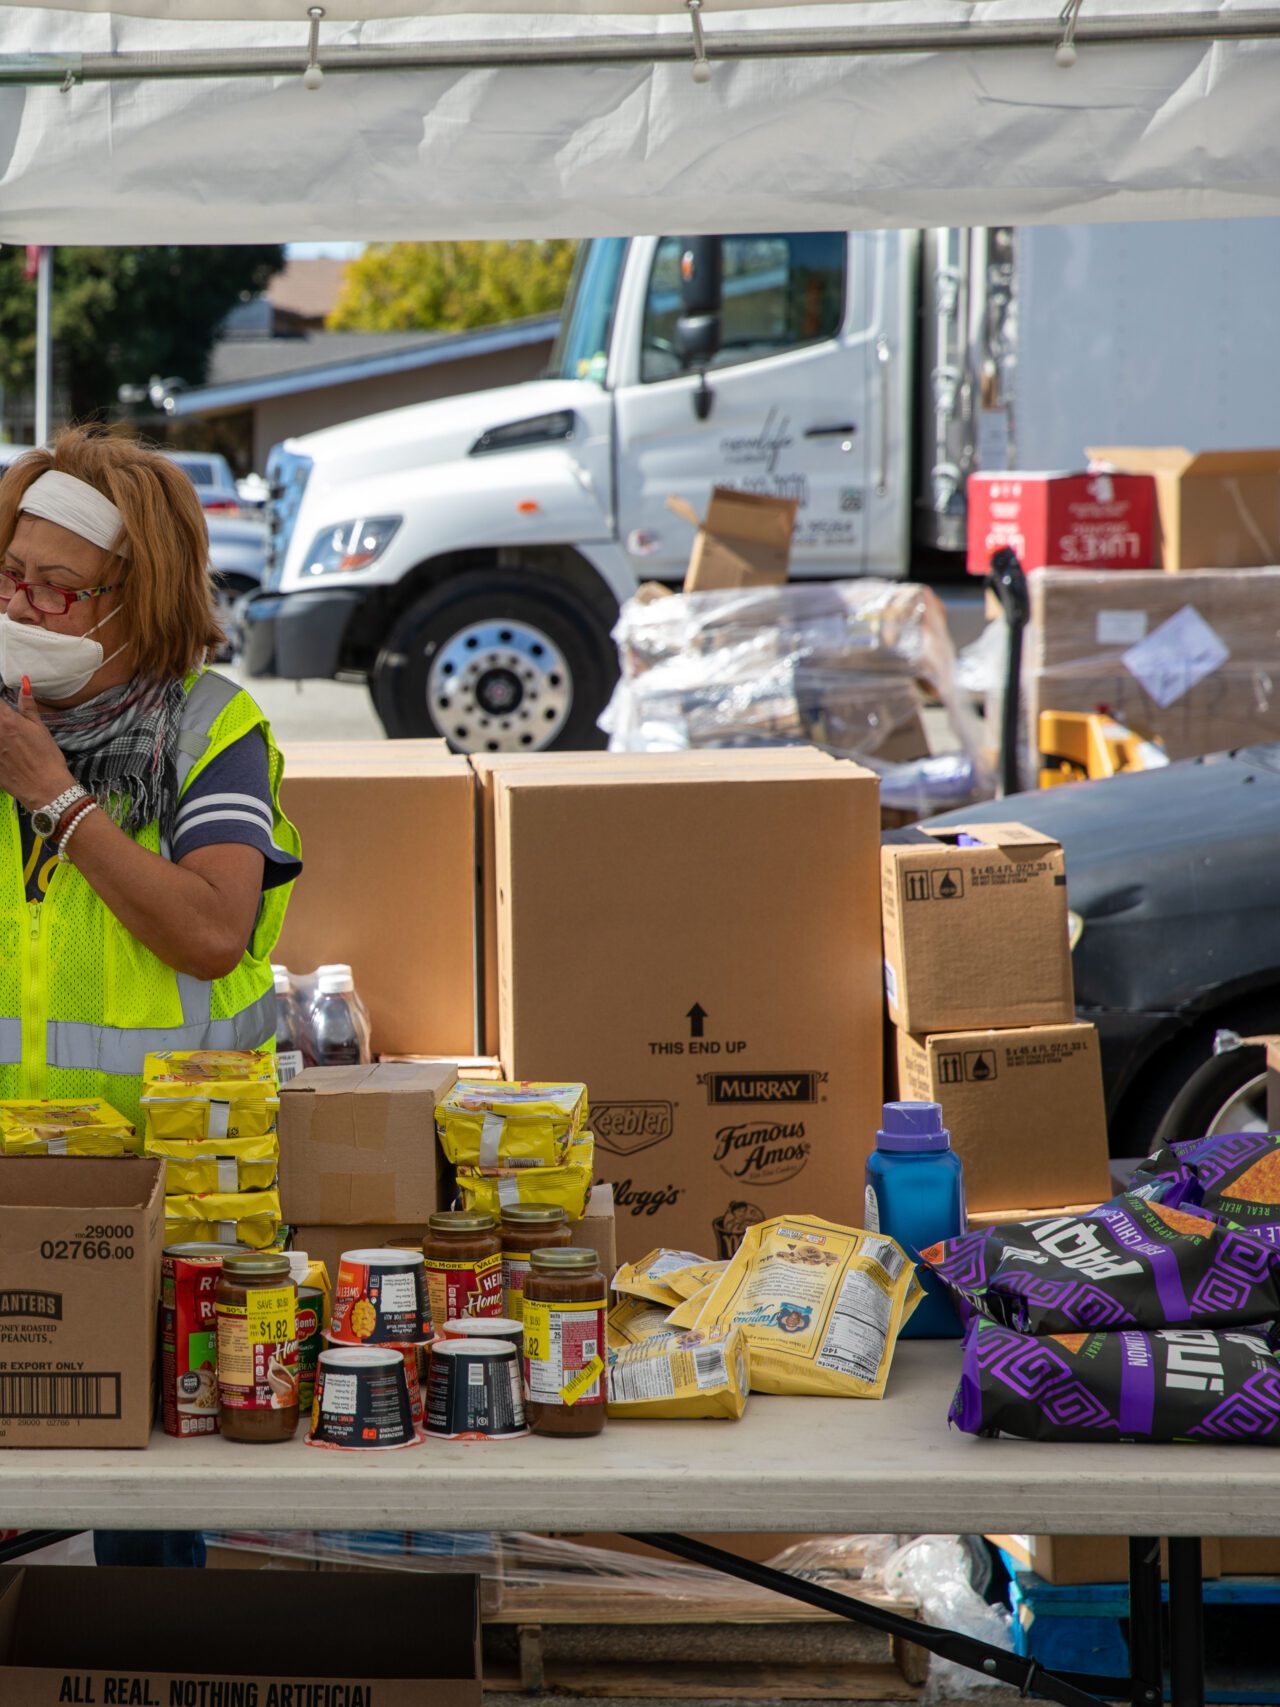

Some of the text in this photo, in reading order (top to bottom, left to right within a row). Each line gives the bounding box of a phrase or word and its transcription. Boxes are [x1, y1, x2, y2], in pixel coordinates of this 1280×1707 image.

[648, 1041, 747, 1055] THIS END UP
[720, 1080, 801, 1099] MURRAY
[588, 1105, 669, 1136] Keebler
[713, 1121, 806, 1161] Famous
[734, 1142, 810, 1177] Amos
[1247, 1206, 1271, 1216] REAL
[1106, 1212, 1142, 1246] CHILE
[476, 1257, 502, 1270] VALUE
[256, 1300, 272, 1310] SAVE
[733, 1311, 779, 1328] Famous
[21, 1324, 57, 1332] ROASTED
[260, 1319, 288, 1340] $1.82
[554, 1331, 562, 1339] 25
[1, 1334, 48, 1343] PEANUTS
[822, 1346, 838, 1355] 140
[11, 1361, 53, 1370] EXPORT
[56, 1361, 84, 1370] ONLY
[818, 1360, 875, 1384] Nutrition Facts
[59, 1675, 96, 1704] ALL
[103, 1676, 160, 1706] REAL.
[169, 1680, 258, 1707] NOTHING
